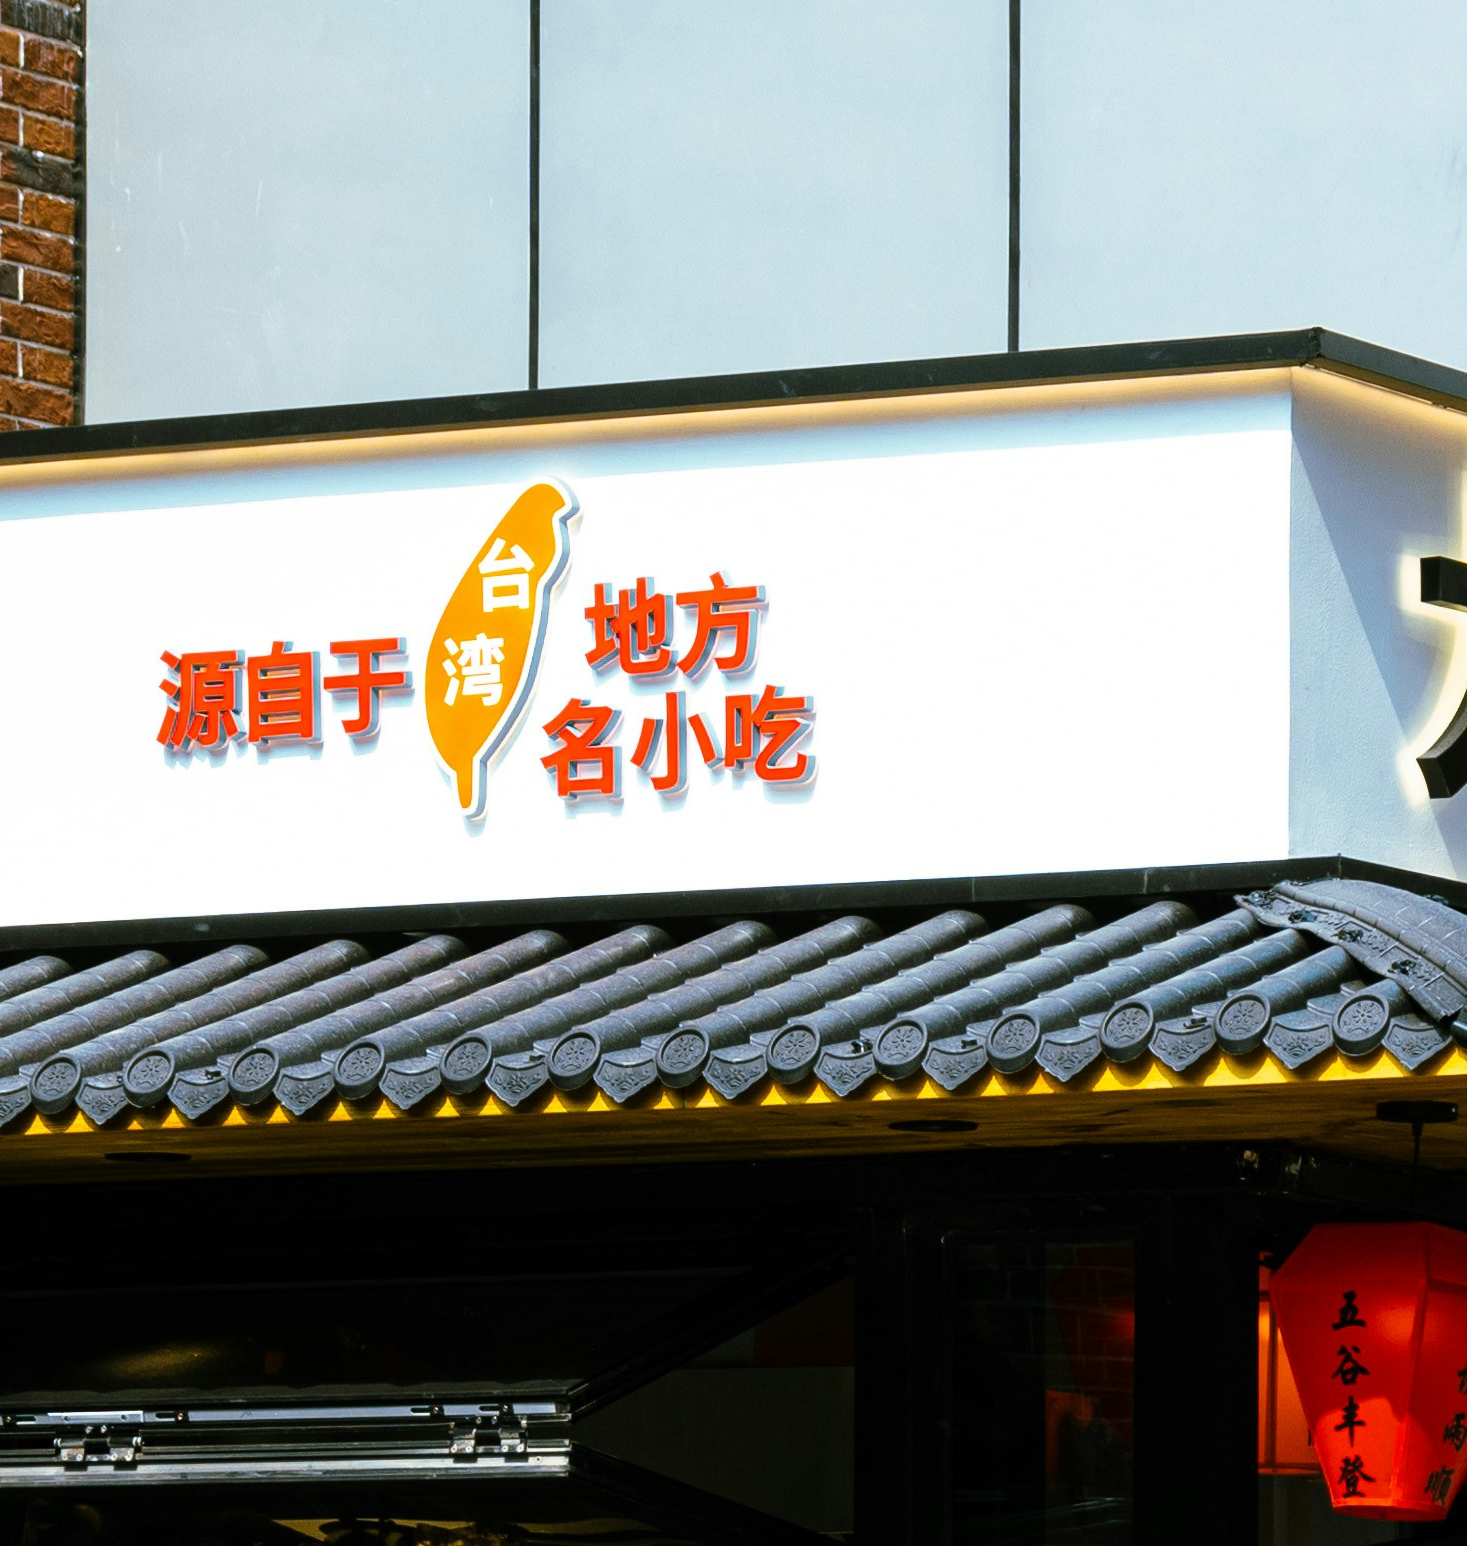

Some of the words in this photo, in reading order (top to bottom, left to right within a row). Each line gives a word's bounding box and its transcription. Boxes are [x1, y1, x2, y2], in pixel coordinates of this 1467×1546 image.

[441, 538, 535, 707] 台湾
[585, 571, 770, 680] 地方
[157, 636, 410, 748] 源自于
[540, 684, 816, 802] 名小吃
[1331, 1290, 1376, 1500] 五谷丰登
